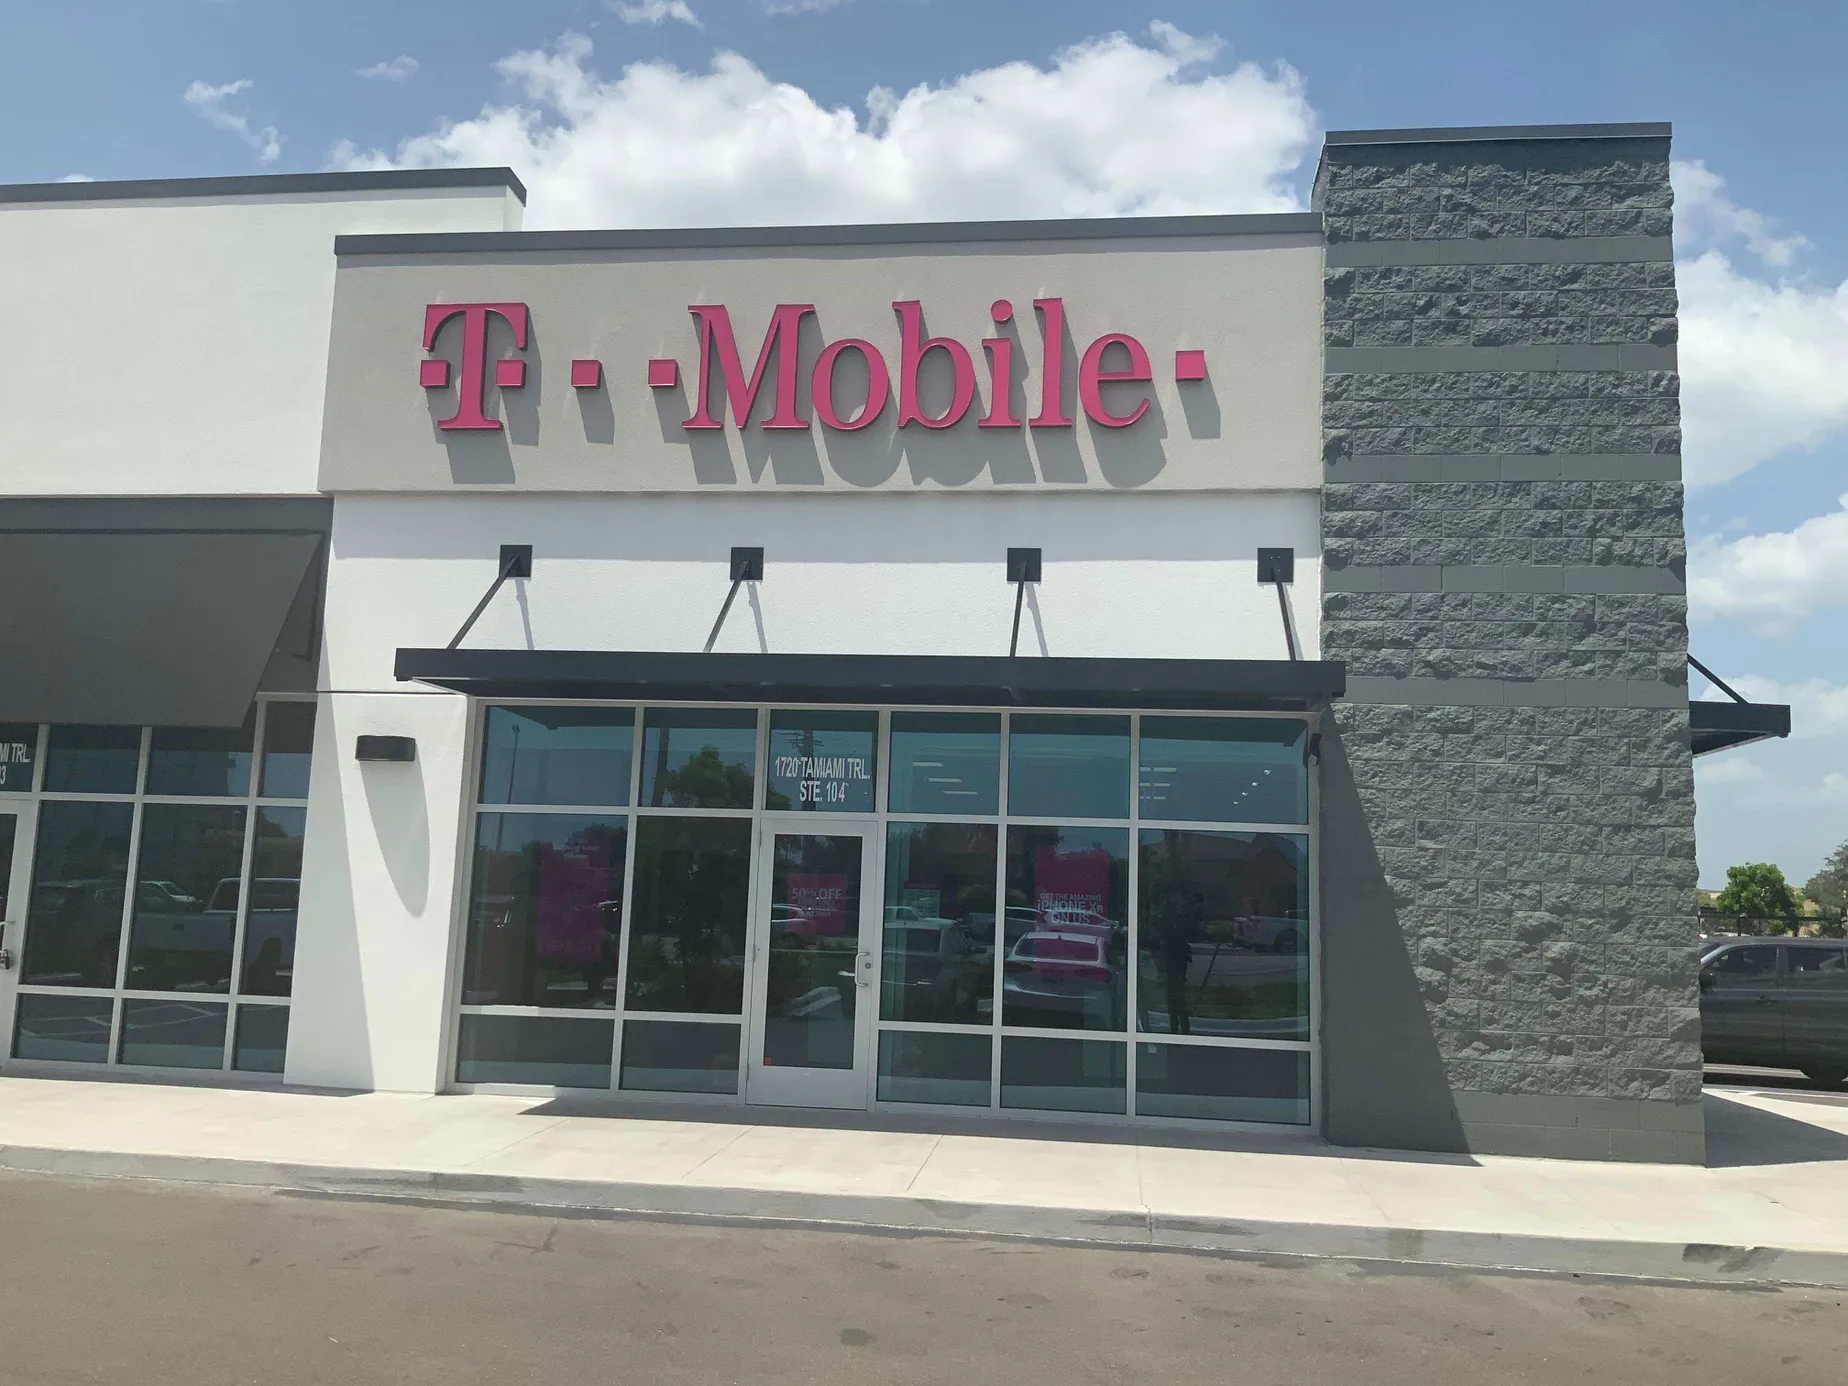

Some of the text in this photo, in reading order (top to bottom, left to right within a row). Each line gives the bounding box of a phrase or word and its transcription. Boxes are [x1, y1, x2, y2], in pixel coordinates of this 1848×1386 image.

[775, 756, 871, 780] 1720 TAMIAMI TRL.
[799, 780, 846, 802] STE. 104
[819, 888, 842, 900] OFF
